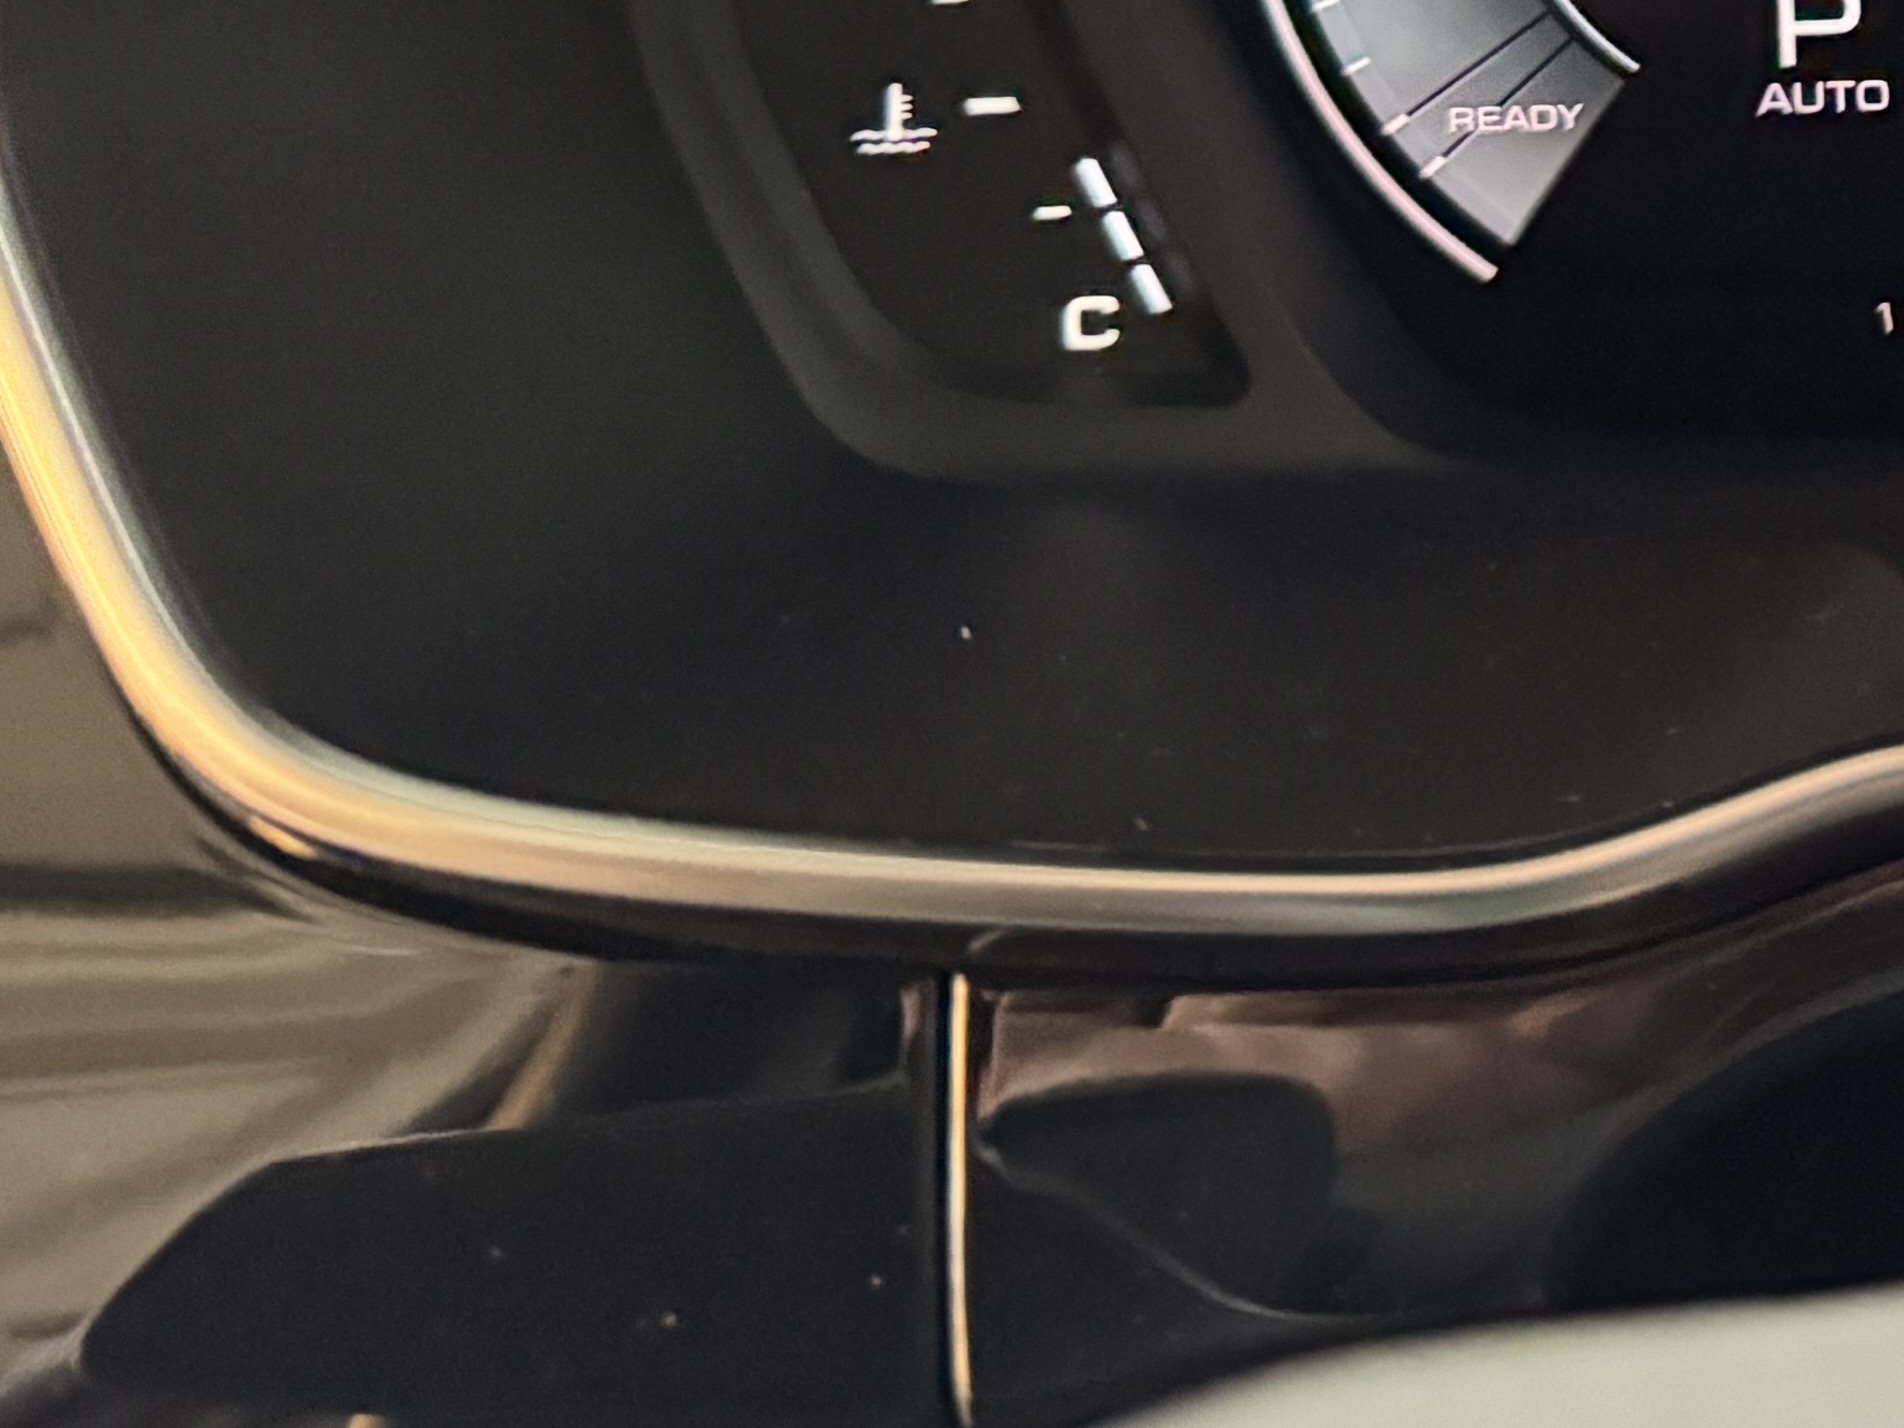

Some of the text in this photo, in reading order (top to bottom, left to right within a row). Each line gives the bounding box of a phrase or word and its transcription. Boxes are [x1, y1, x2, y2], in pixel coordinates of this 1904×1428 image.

[1756, 78, 1891, 117] AUTO
[1445, 102, 1586, 135] READY
[1062, 294, 1121, 352] C
[1874, 300, 1895, 336] 1
